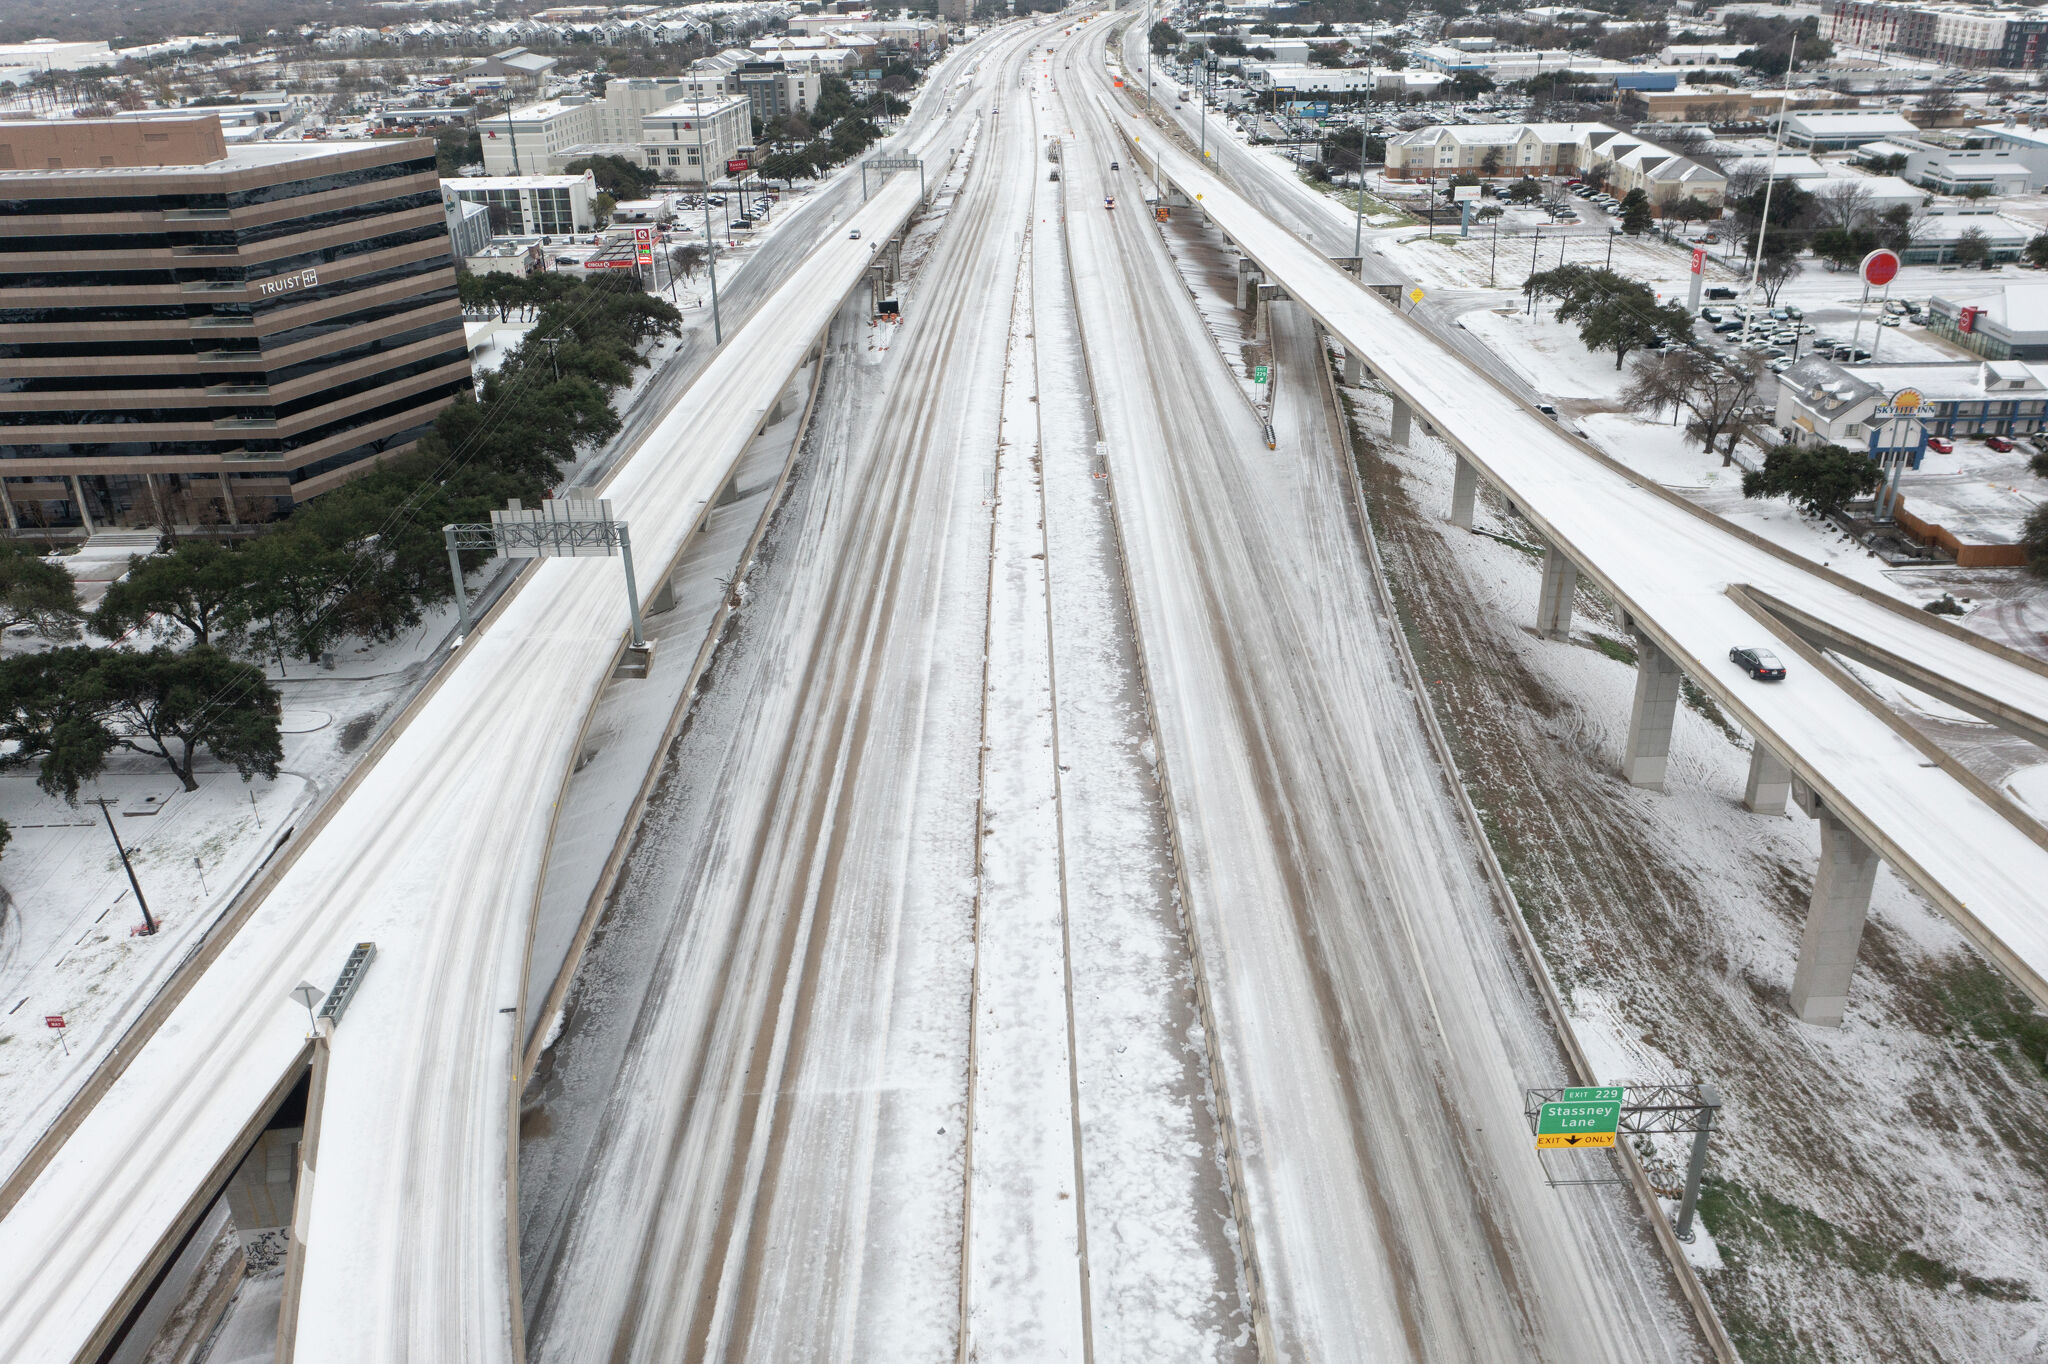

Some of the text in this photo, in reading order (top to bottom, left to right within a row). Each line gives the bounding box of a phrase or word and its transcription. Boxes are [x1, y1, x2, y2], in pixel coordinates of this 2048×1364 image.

[259, 276, 300, 295] TRUIST
[1877, 406, 1936, 414] SKYLITE INN
[1595, 1089, 1618, 1099] 229
[1548, 1106, 1613, 1117] Stassney
[1561, 1118, 1596, 1127] Lane
[1584, 1136, 1613, 1144] ONLY
